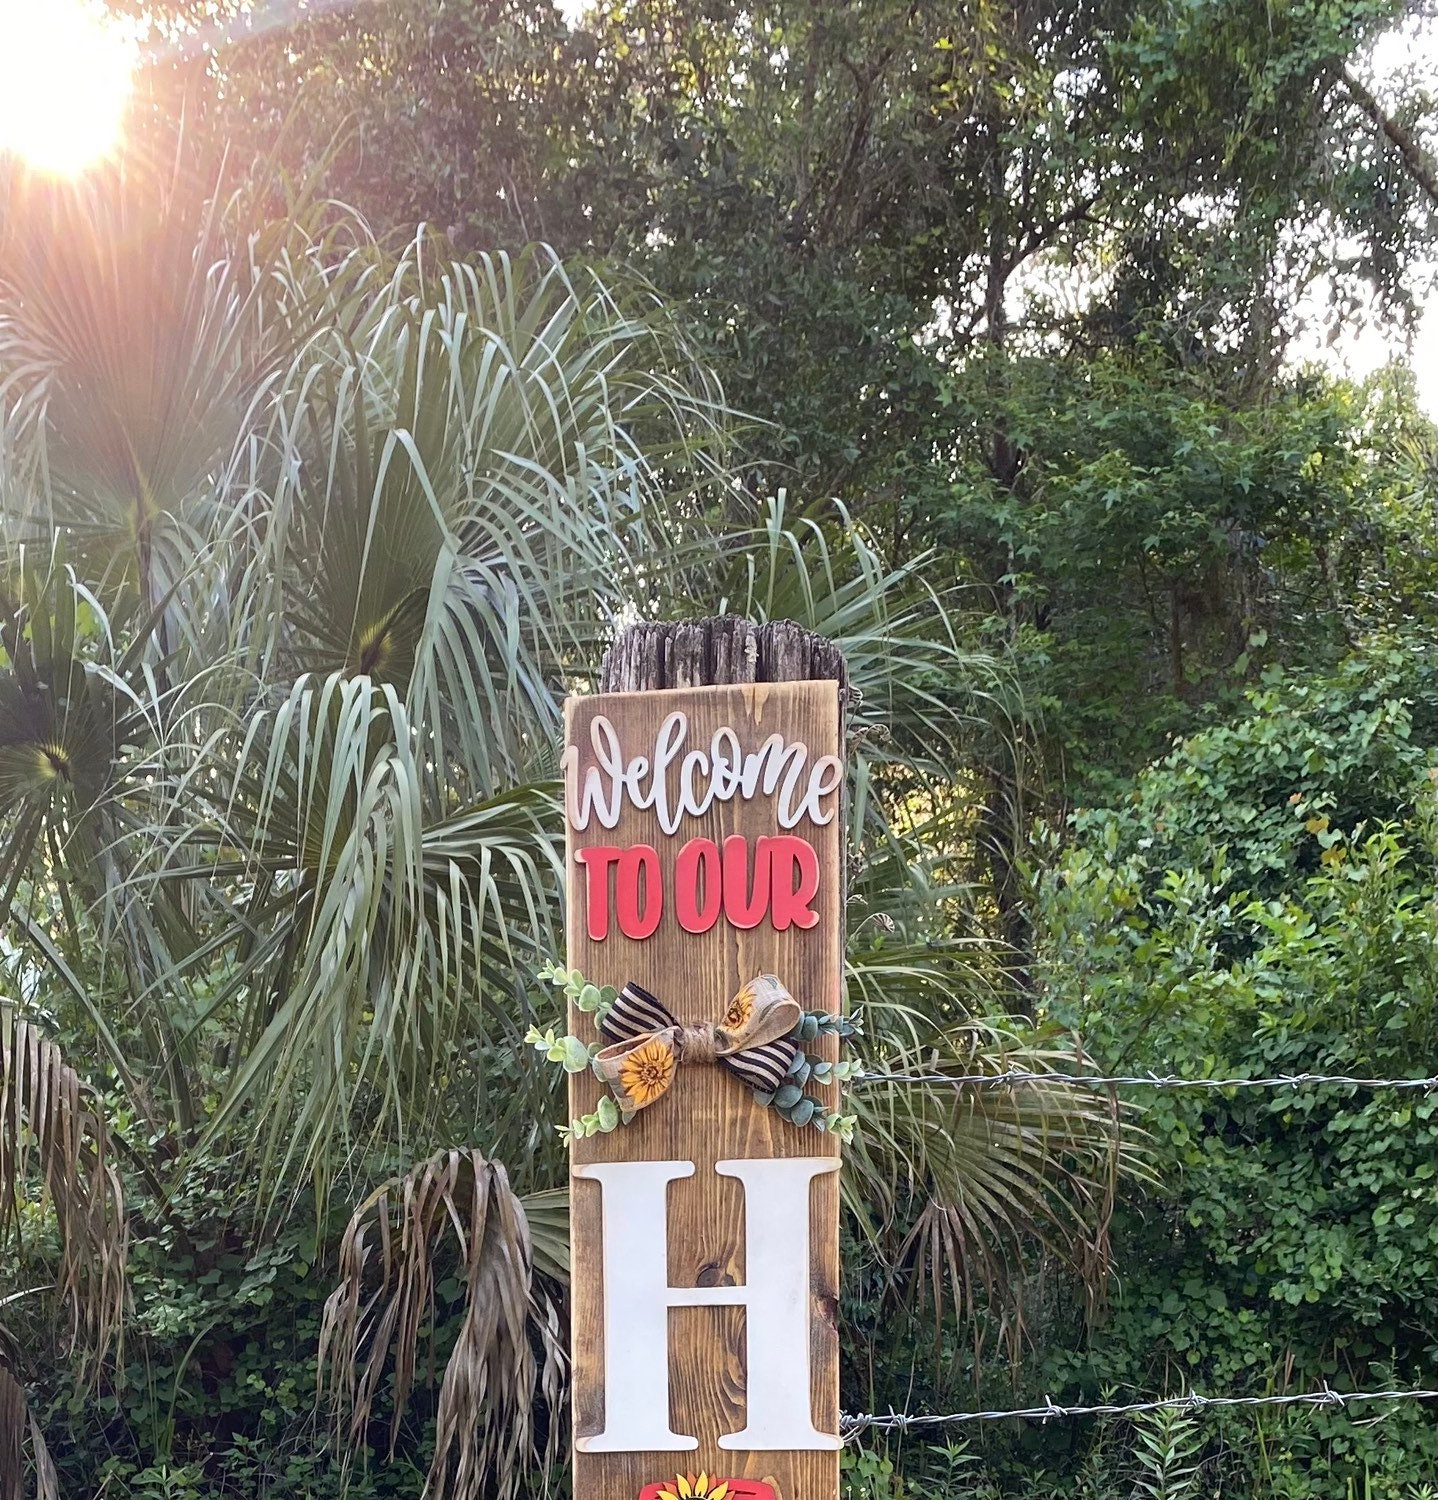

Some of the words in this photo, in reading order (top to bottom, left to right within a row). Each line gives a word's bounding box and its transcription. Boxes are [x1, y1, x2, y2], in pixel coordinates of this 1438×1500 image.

[560, 711, 843, 835] Welcome
[574, 843, 663, 941] TO
[675, 834, 820, 934] OUR
